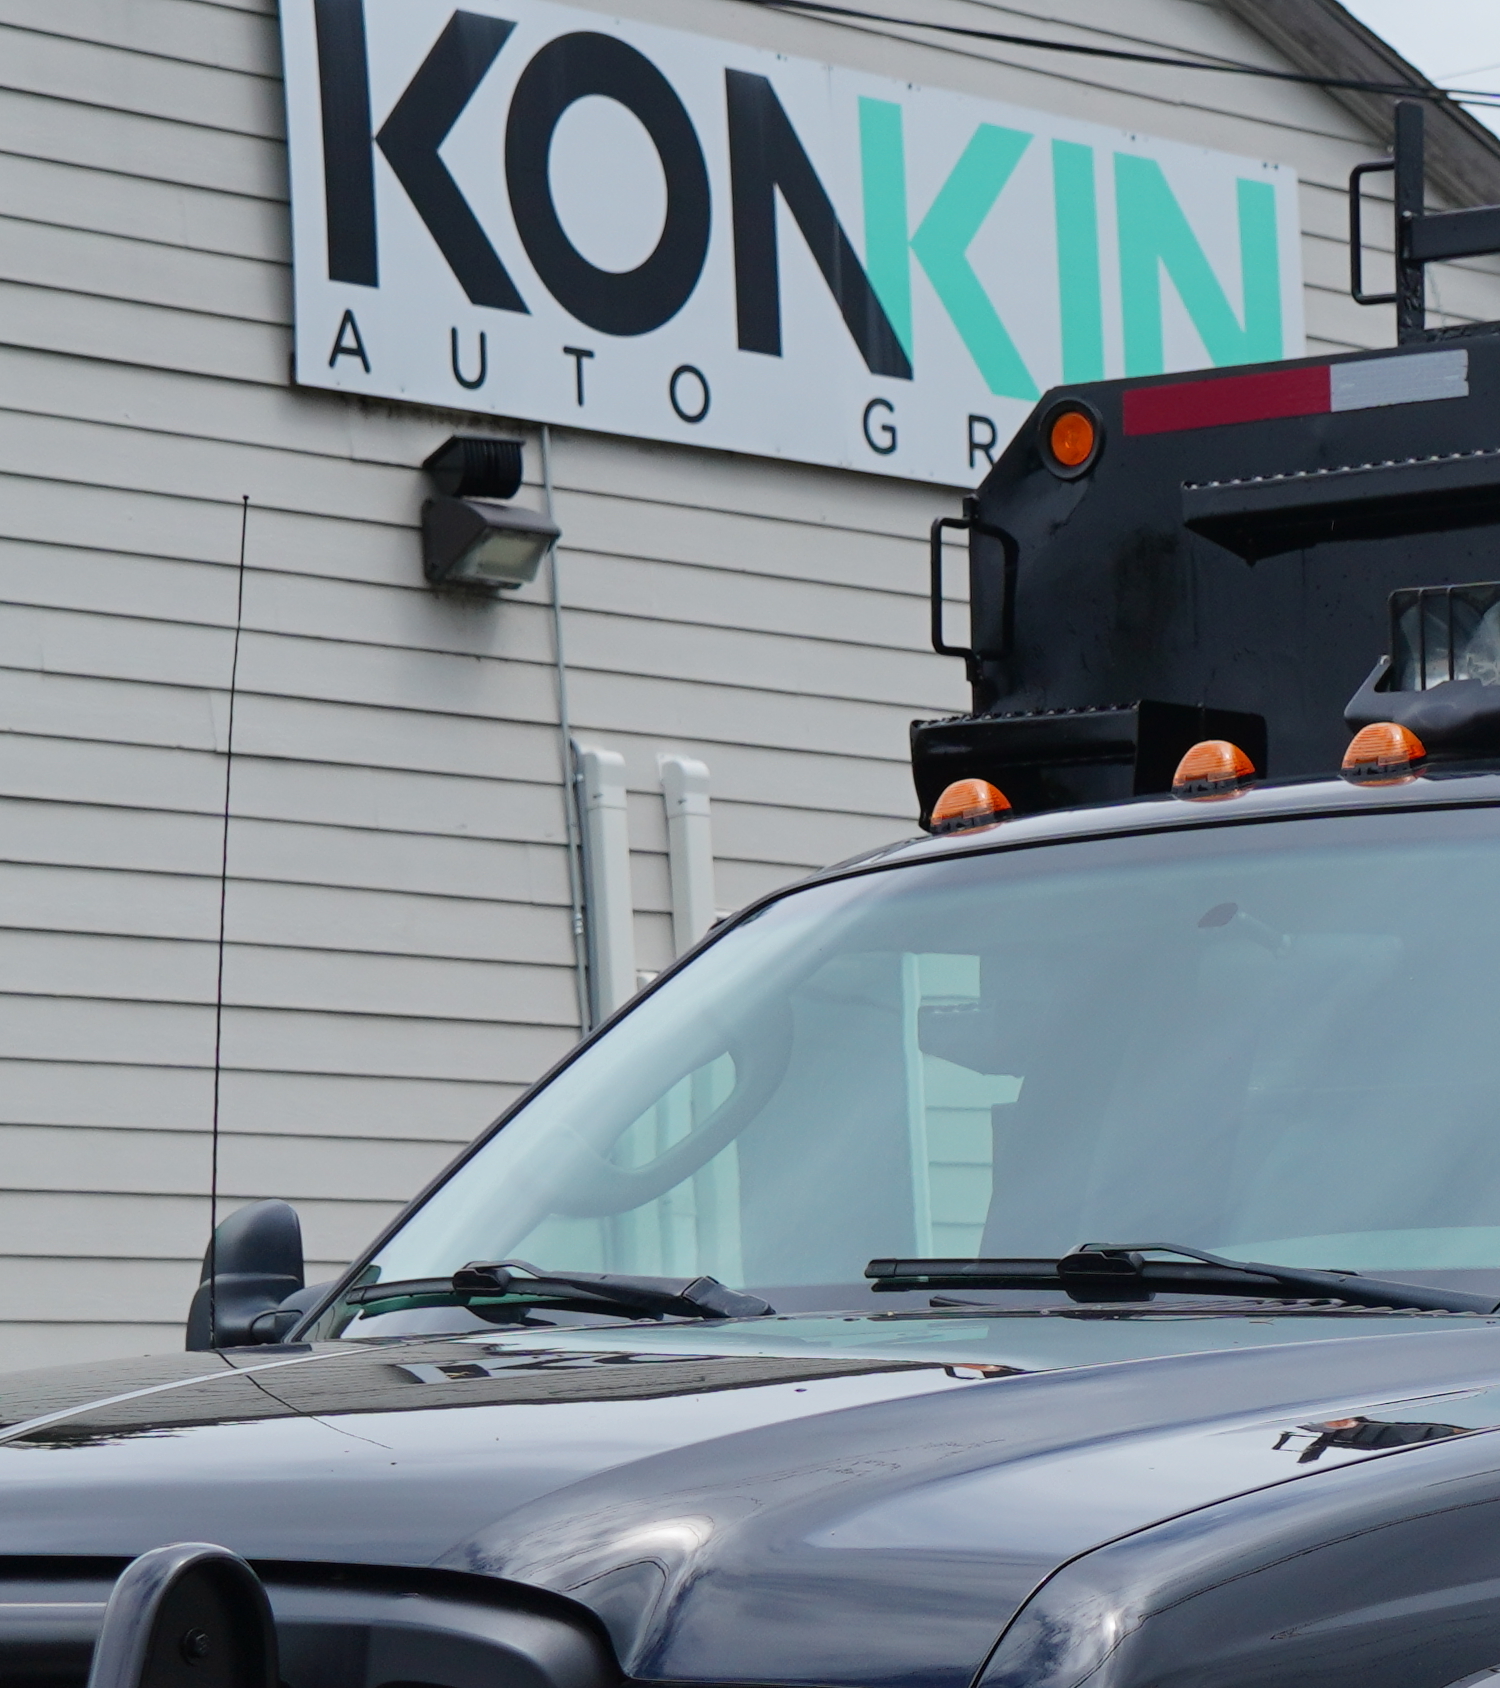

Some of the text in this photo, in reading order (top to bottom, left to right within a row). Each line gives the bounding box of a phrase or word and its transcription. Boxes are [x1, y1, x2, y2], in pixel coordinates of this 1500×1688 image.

[315, 0, 1284, 402] KONKIN
[328, 309, 998, 470] AUTO GR
